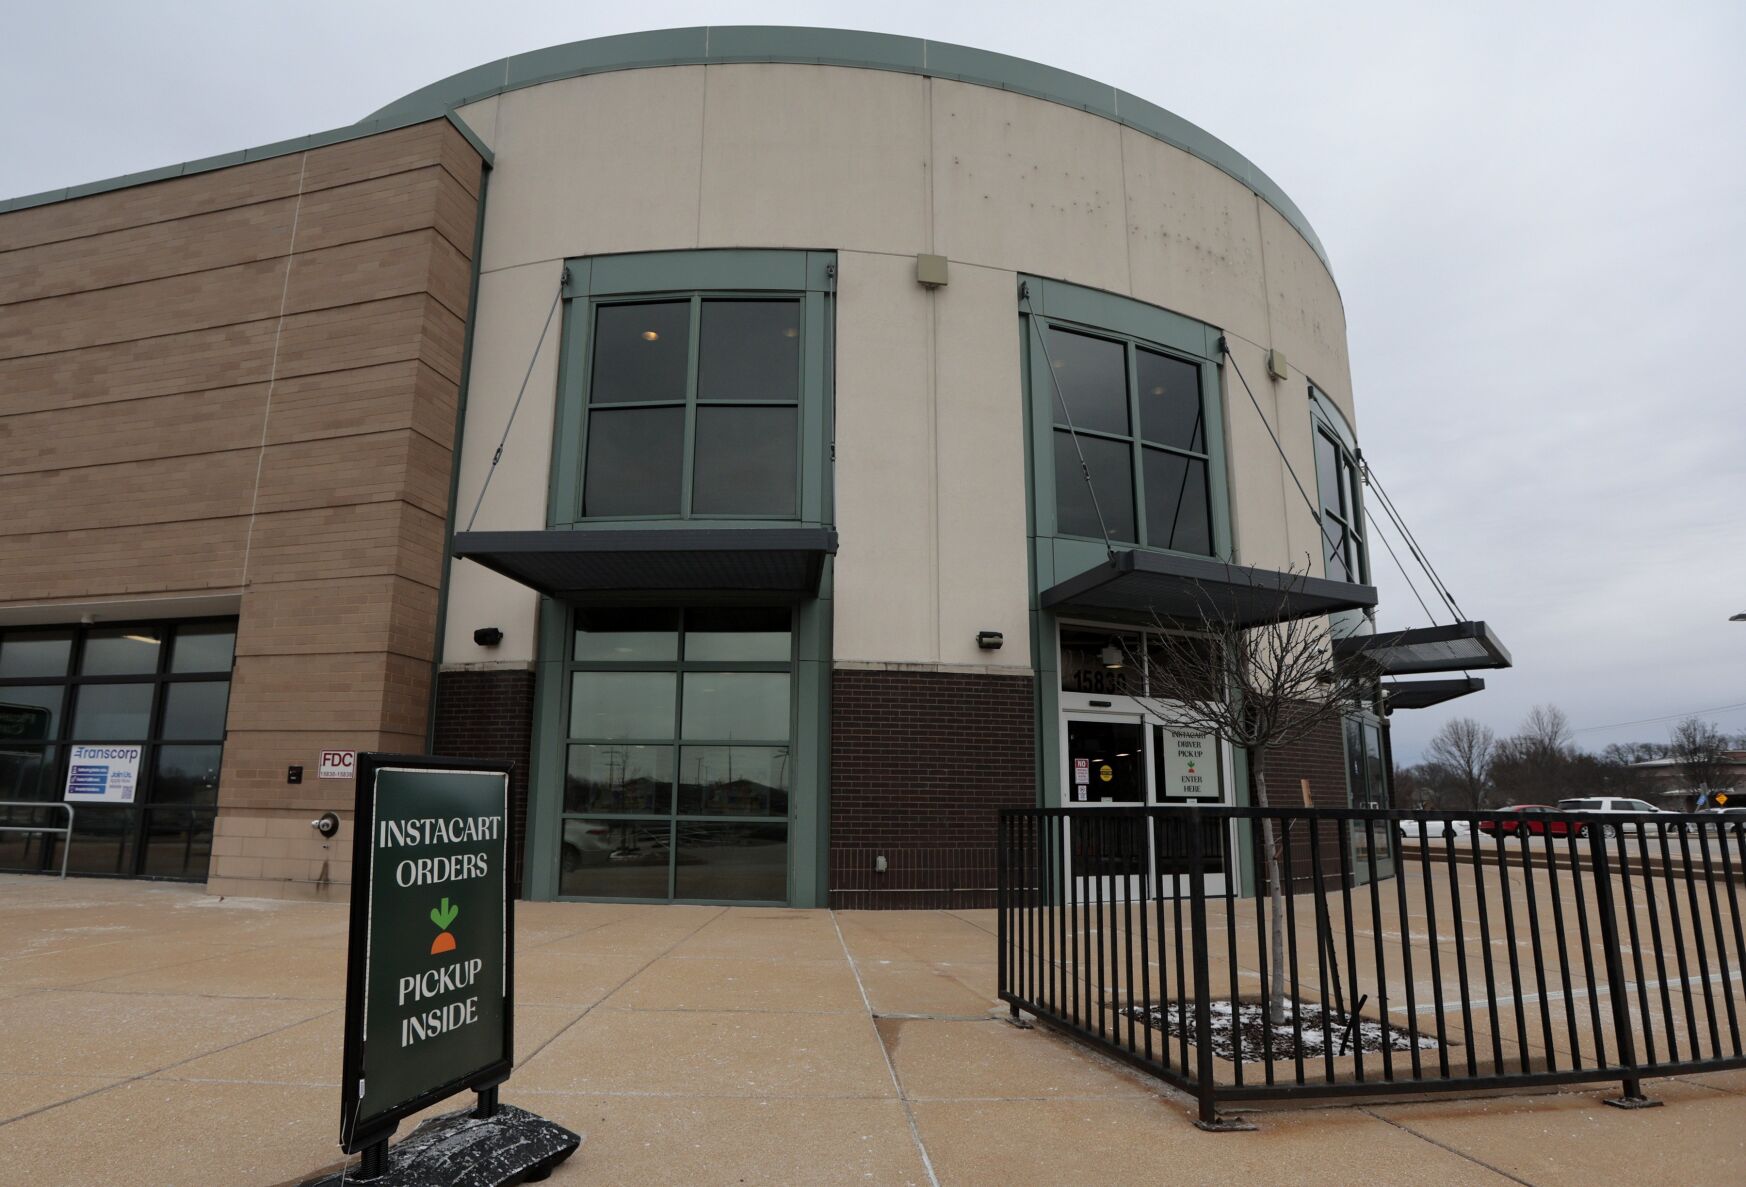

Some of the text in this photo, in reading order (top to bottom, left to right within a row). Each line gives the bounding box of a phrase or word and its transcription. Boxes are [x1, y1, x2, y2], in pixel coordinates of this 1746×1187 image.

[73, 747, 138, 763] Transcorp
[323, 753, 353, 767] FDC
[379, 816, 501, 848] INSTACART
[395, 852, 489, 888] ORDERS
[398, 958, 484, 1006] PICKUP
[401, 996, 480, 1048] INSIDE
